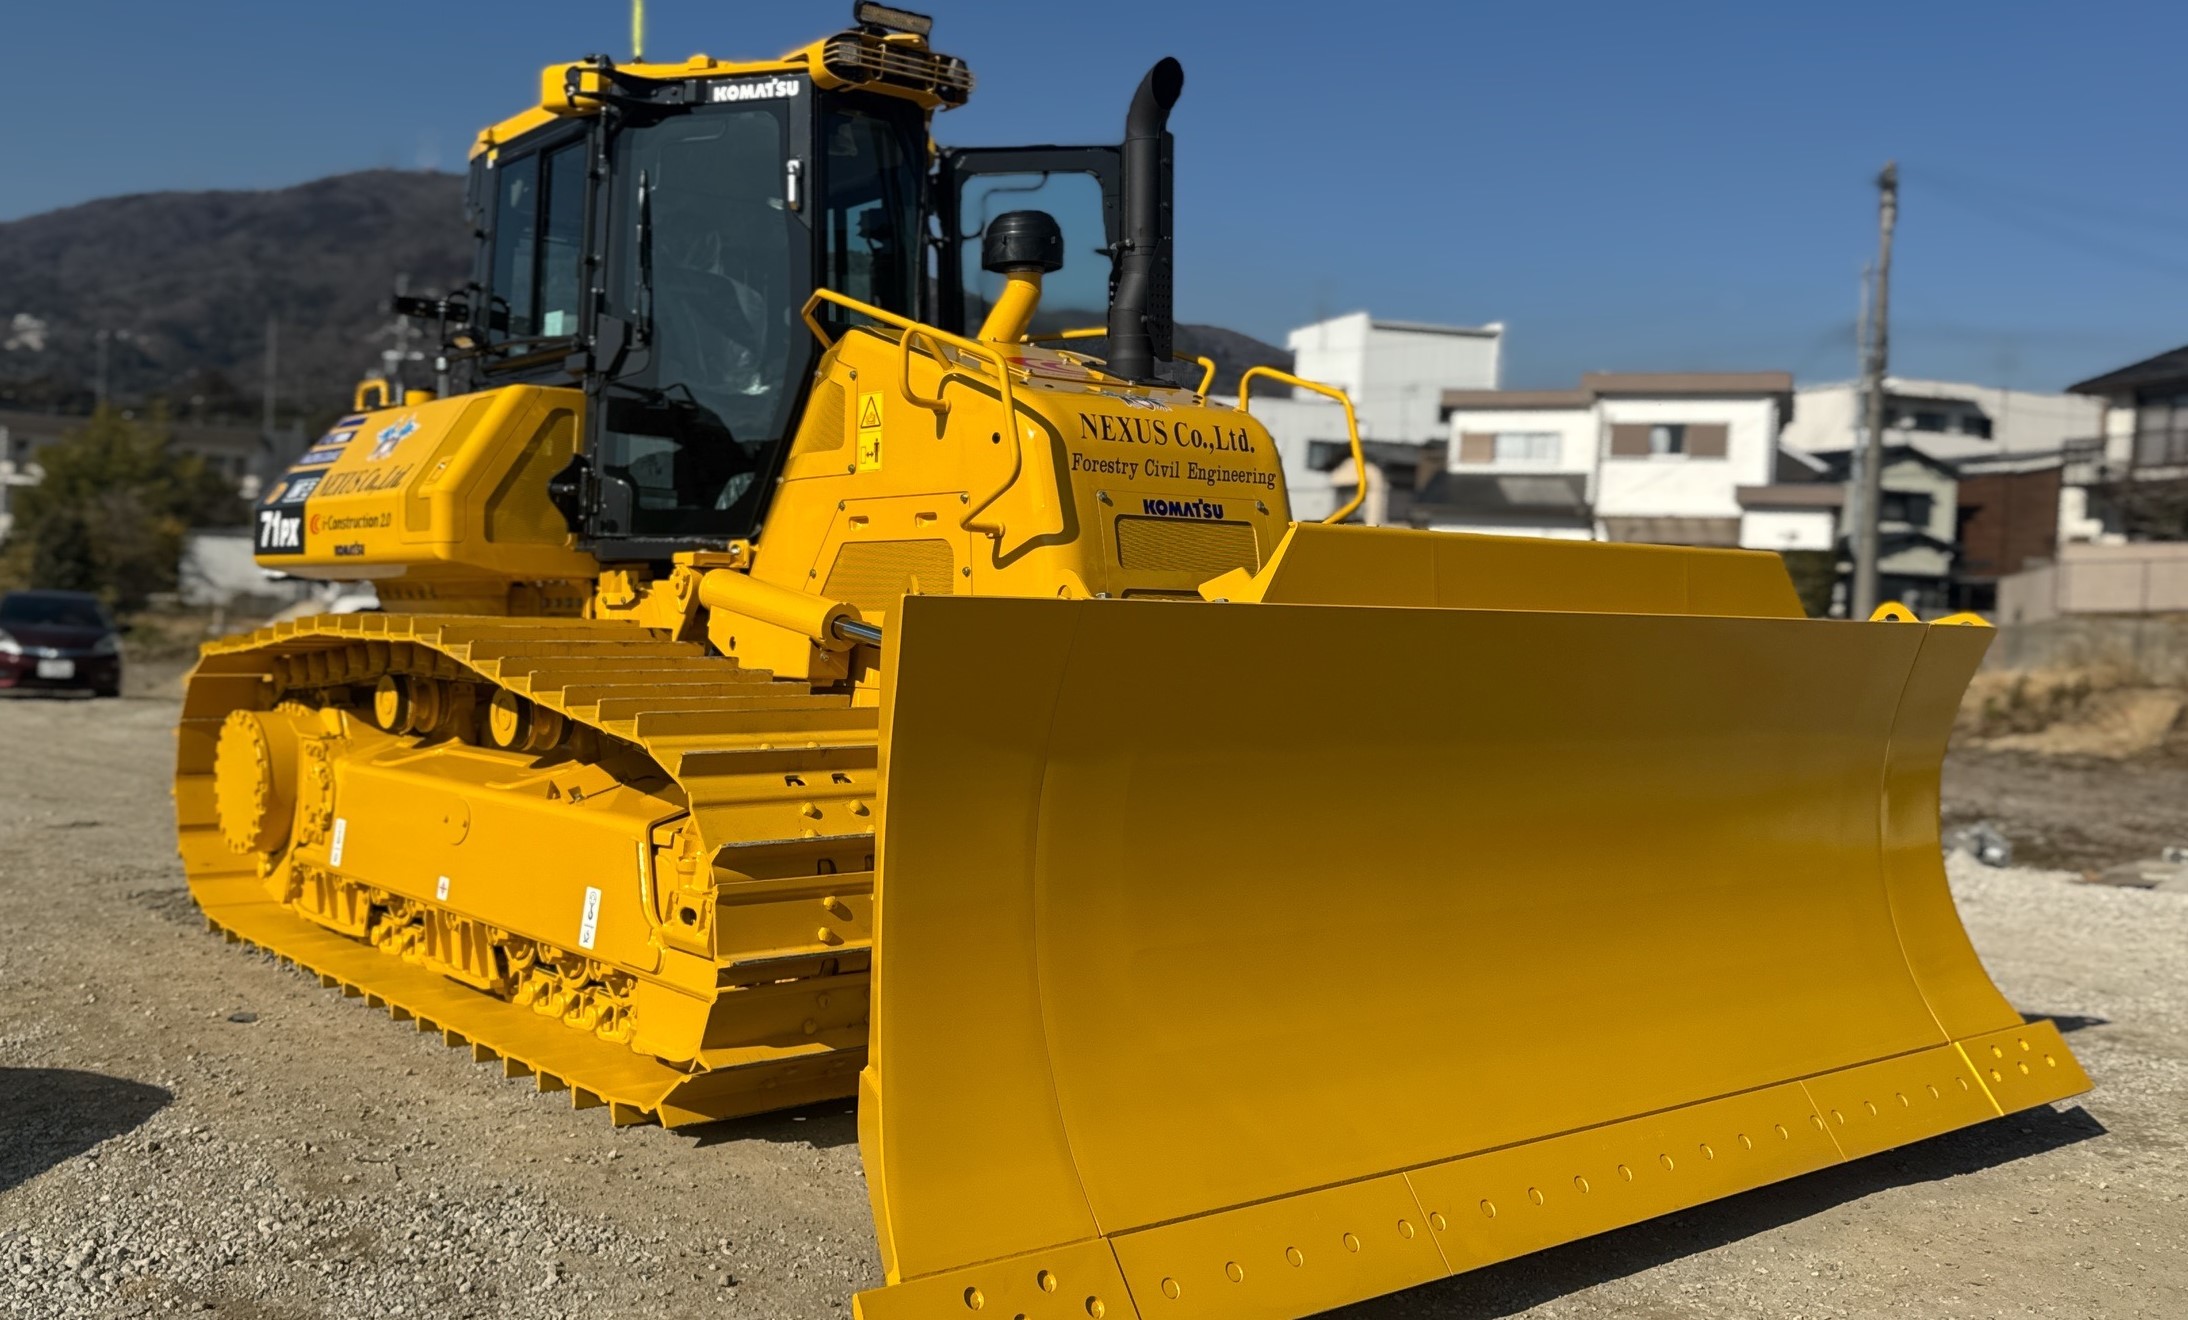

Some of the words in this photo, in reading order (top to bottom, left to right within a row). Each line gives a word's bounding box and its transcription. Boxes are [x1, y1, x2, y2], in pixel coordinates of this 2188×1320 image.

[713, 78, 799, 101] KOMATSU
[1079, 413, 1168, 446] NEXUS
[1174, 421, 1255, 454] Co.,Ltd.
[1071, 453, 1139, 481] Forestry
[1144, 458, 1180, 479] Civil
[1187, 462, 1277, 490] Engineering
[321, 513, 379, 531] i-Construction
[1142, 498, 1224, 519] KOMATSU
[260, 510, 301, 548] 71PX
